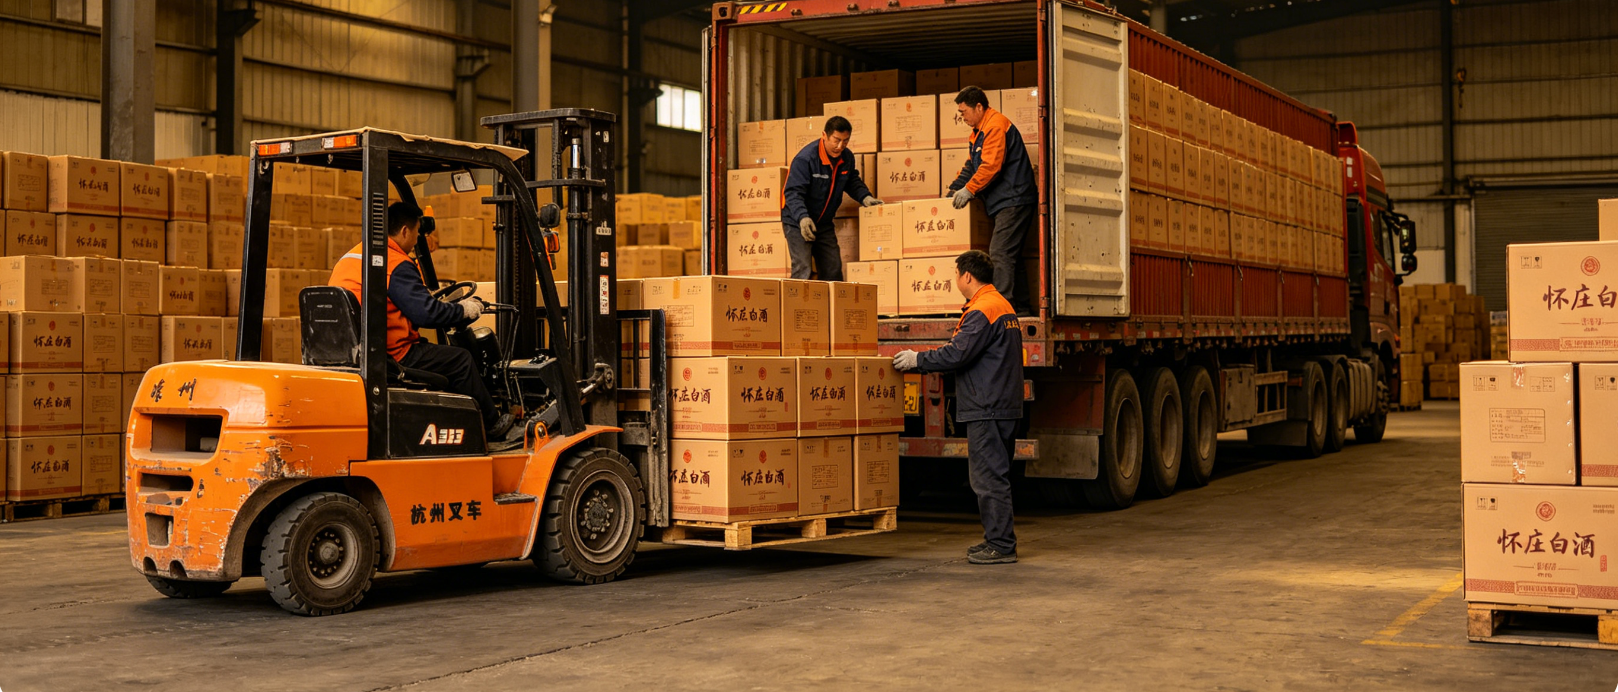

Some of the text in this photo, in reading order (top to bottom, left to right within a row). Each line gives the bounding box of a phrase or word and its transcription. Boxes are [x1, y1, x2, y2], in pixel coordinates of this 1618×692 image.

[725, 305, 768, 323] 怀庄白酒
[740, 386, 784, 403] 怀庄白酒
[740, 469, 784, 486] 怀庄白酒
[410, 500, 482, 525] 杭州叉车
[1497, 528, 1595, 558] 怀庄白酒
